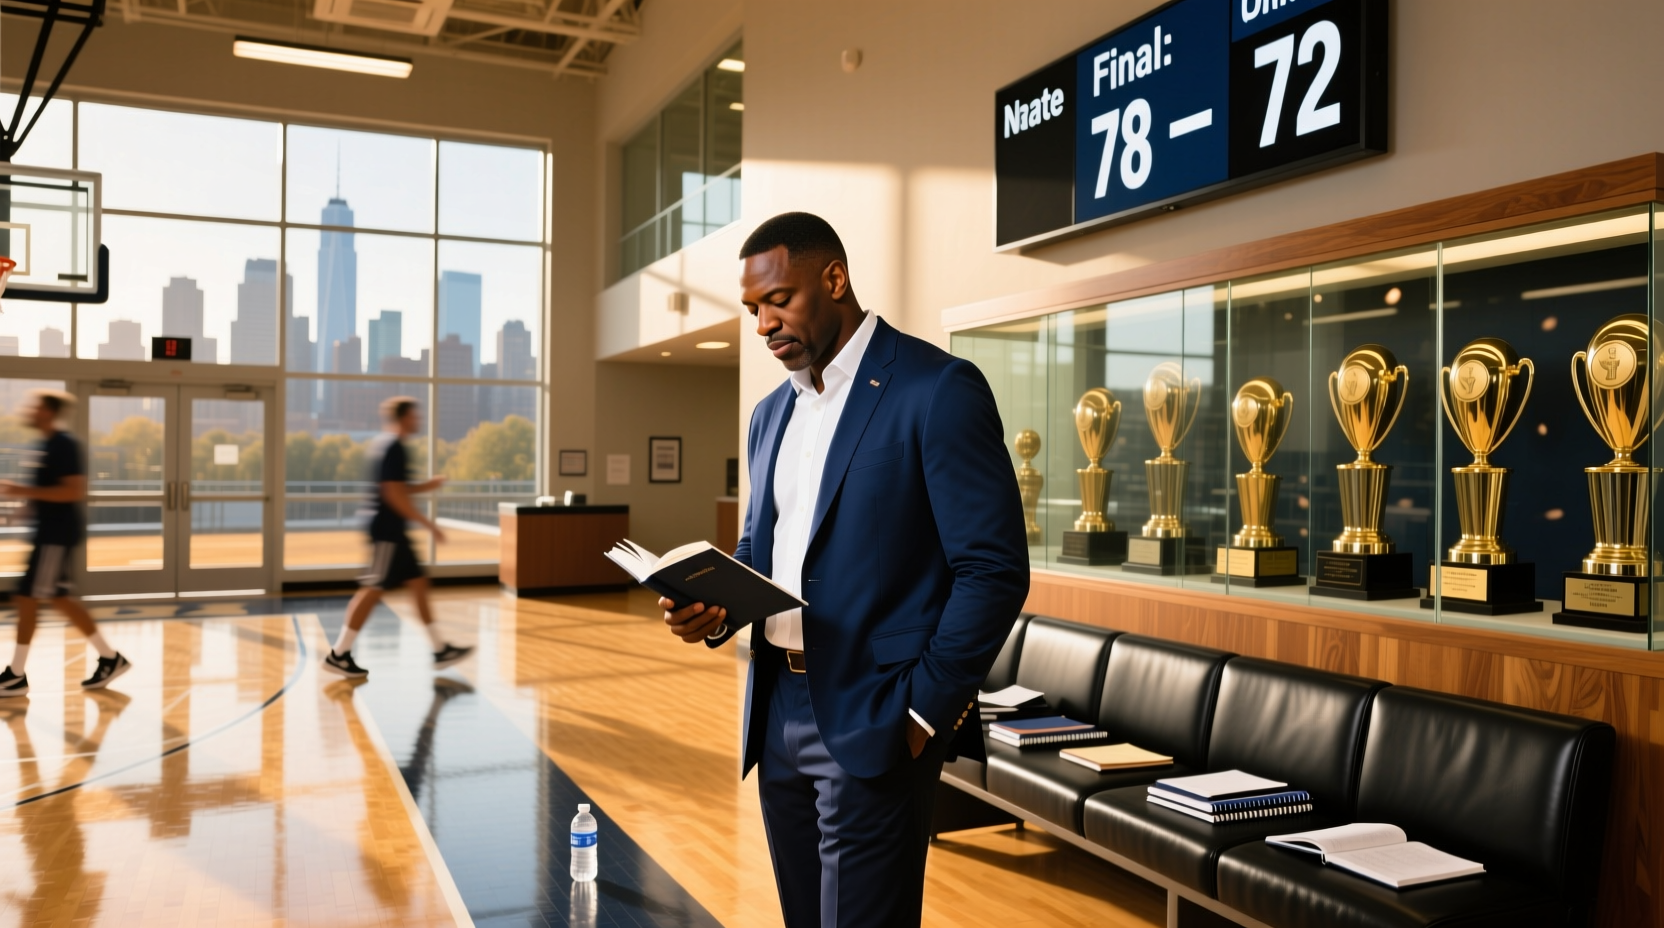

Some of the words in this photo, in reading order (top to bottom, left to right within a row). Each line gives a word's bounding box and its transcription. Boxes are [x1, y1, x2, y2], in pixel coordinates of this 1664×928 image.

[1092, 99, 1152, 199] 78
[1254, 20, 1341, 148] 72
[1093, 26, 1172, 97] Final:
